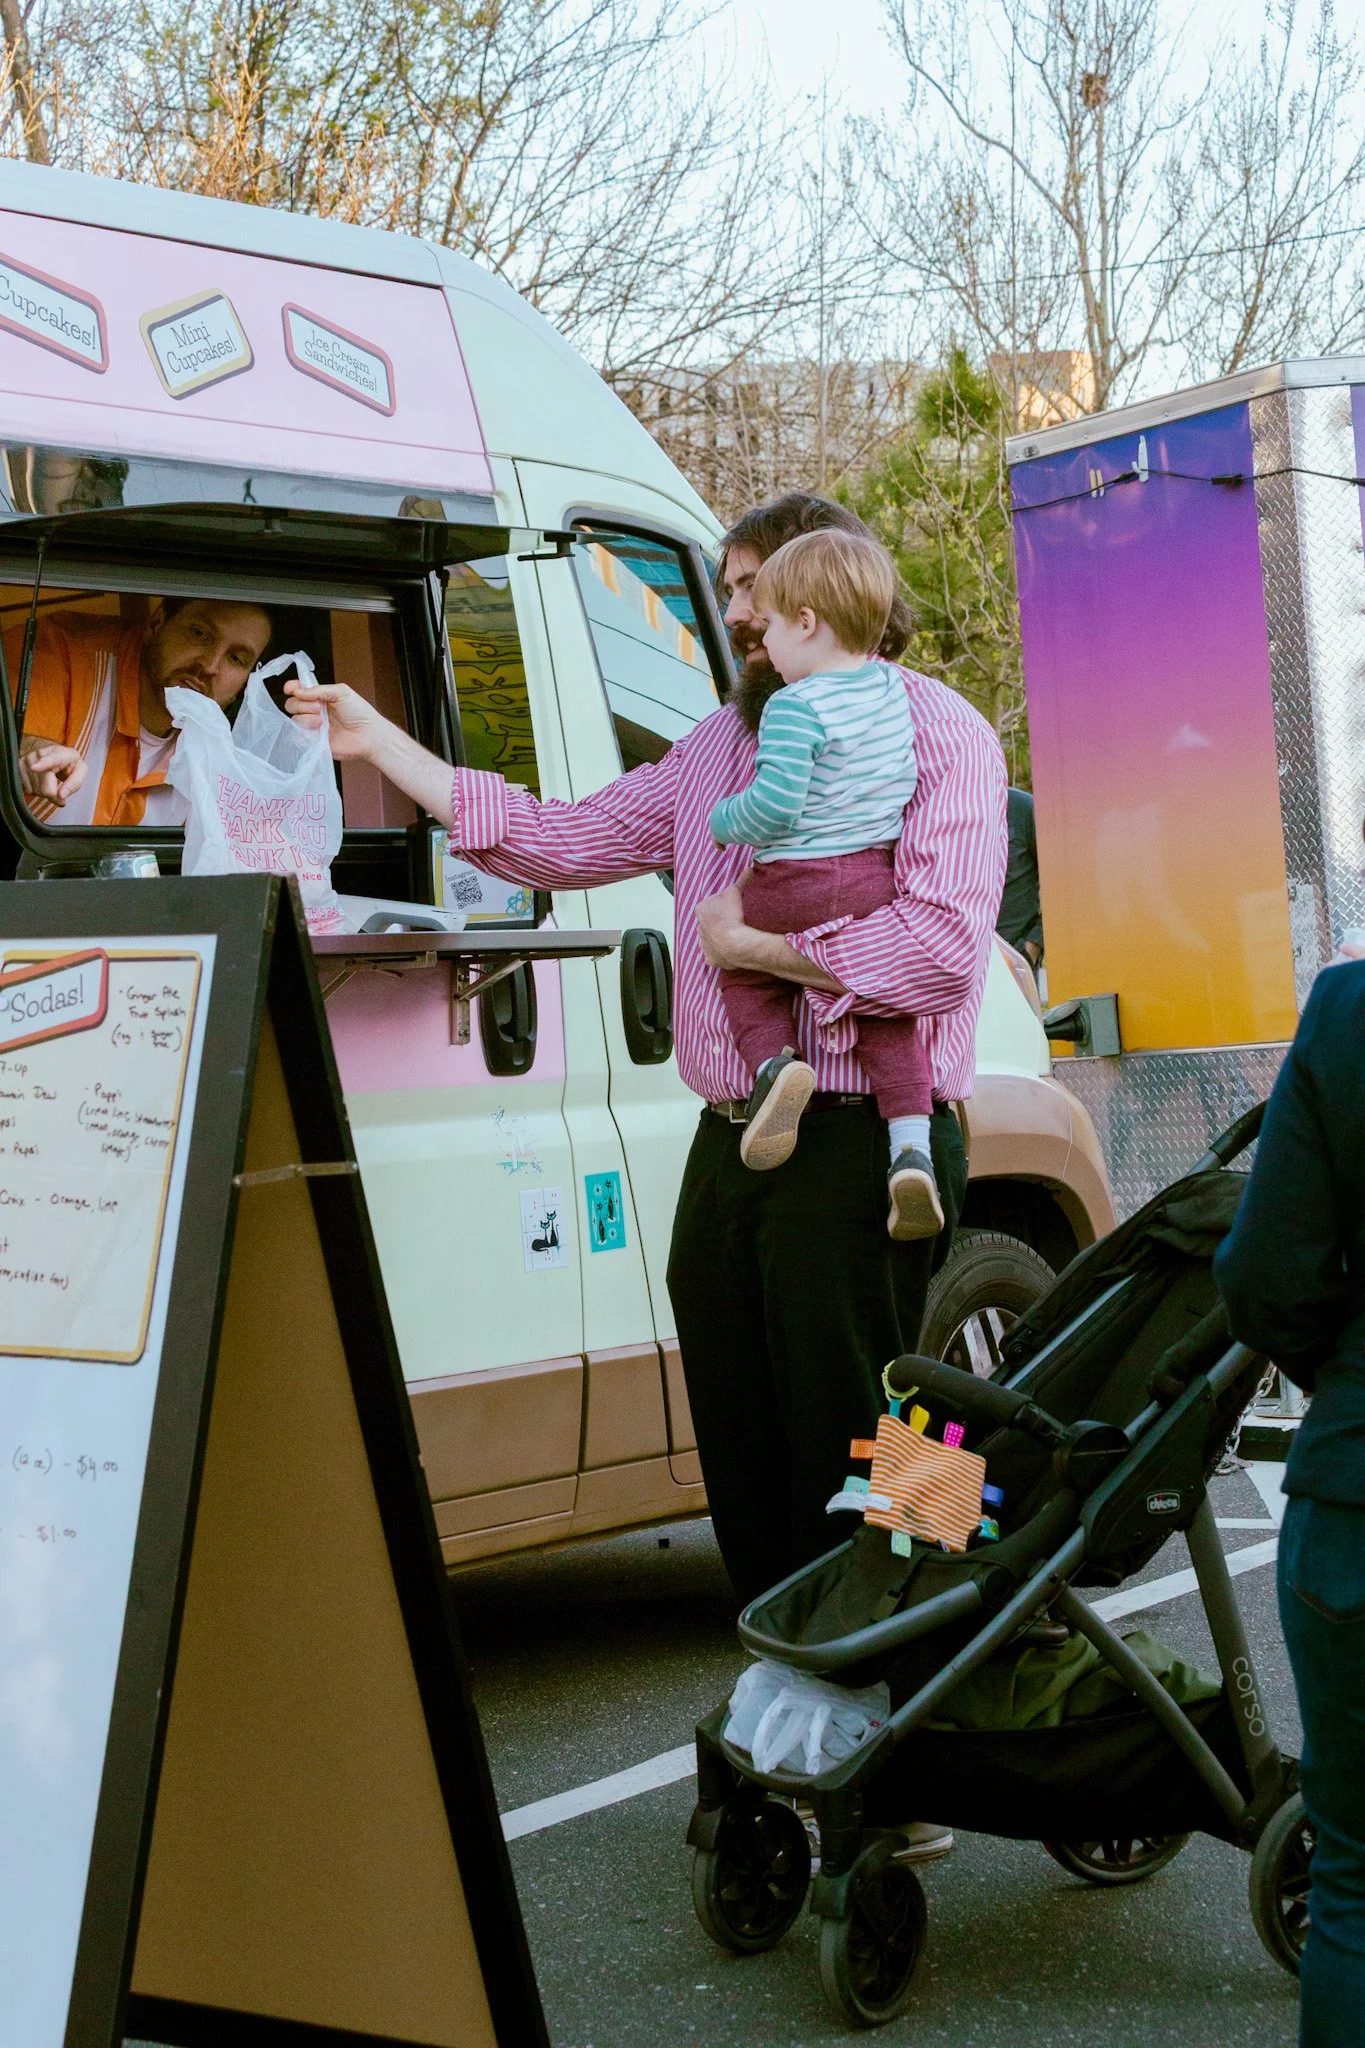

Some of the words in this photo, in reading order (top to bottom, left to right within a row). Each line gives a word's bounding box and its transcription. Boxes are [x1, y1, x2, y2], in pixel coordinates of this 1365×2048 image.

[0, 274, 97, 351] Cupcakes!
[169, 320, 211, 349] Mini
[166, 328, 237, 373] Cupcakes!
[304, 340, 378, 394] Sandwiches!
[311, 328, 330, 352] Ice
[331, 341, 372, 376] Cream
[11, 973, 84, 1024] Sodas!
[77, 1454, 119, 1482] $4.00
[1150, 1497, 1178, 1510] chicco
[1232, 1656, 1265, 1737] corso
